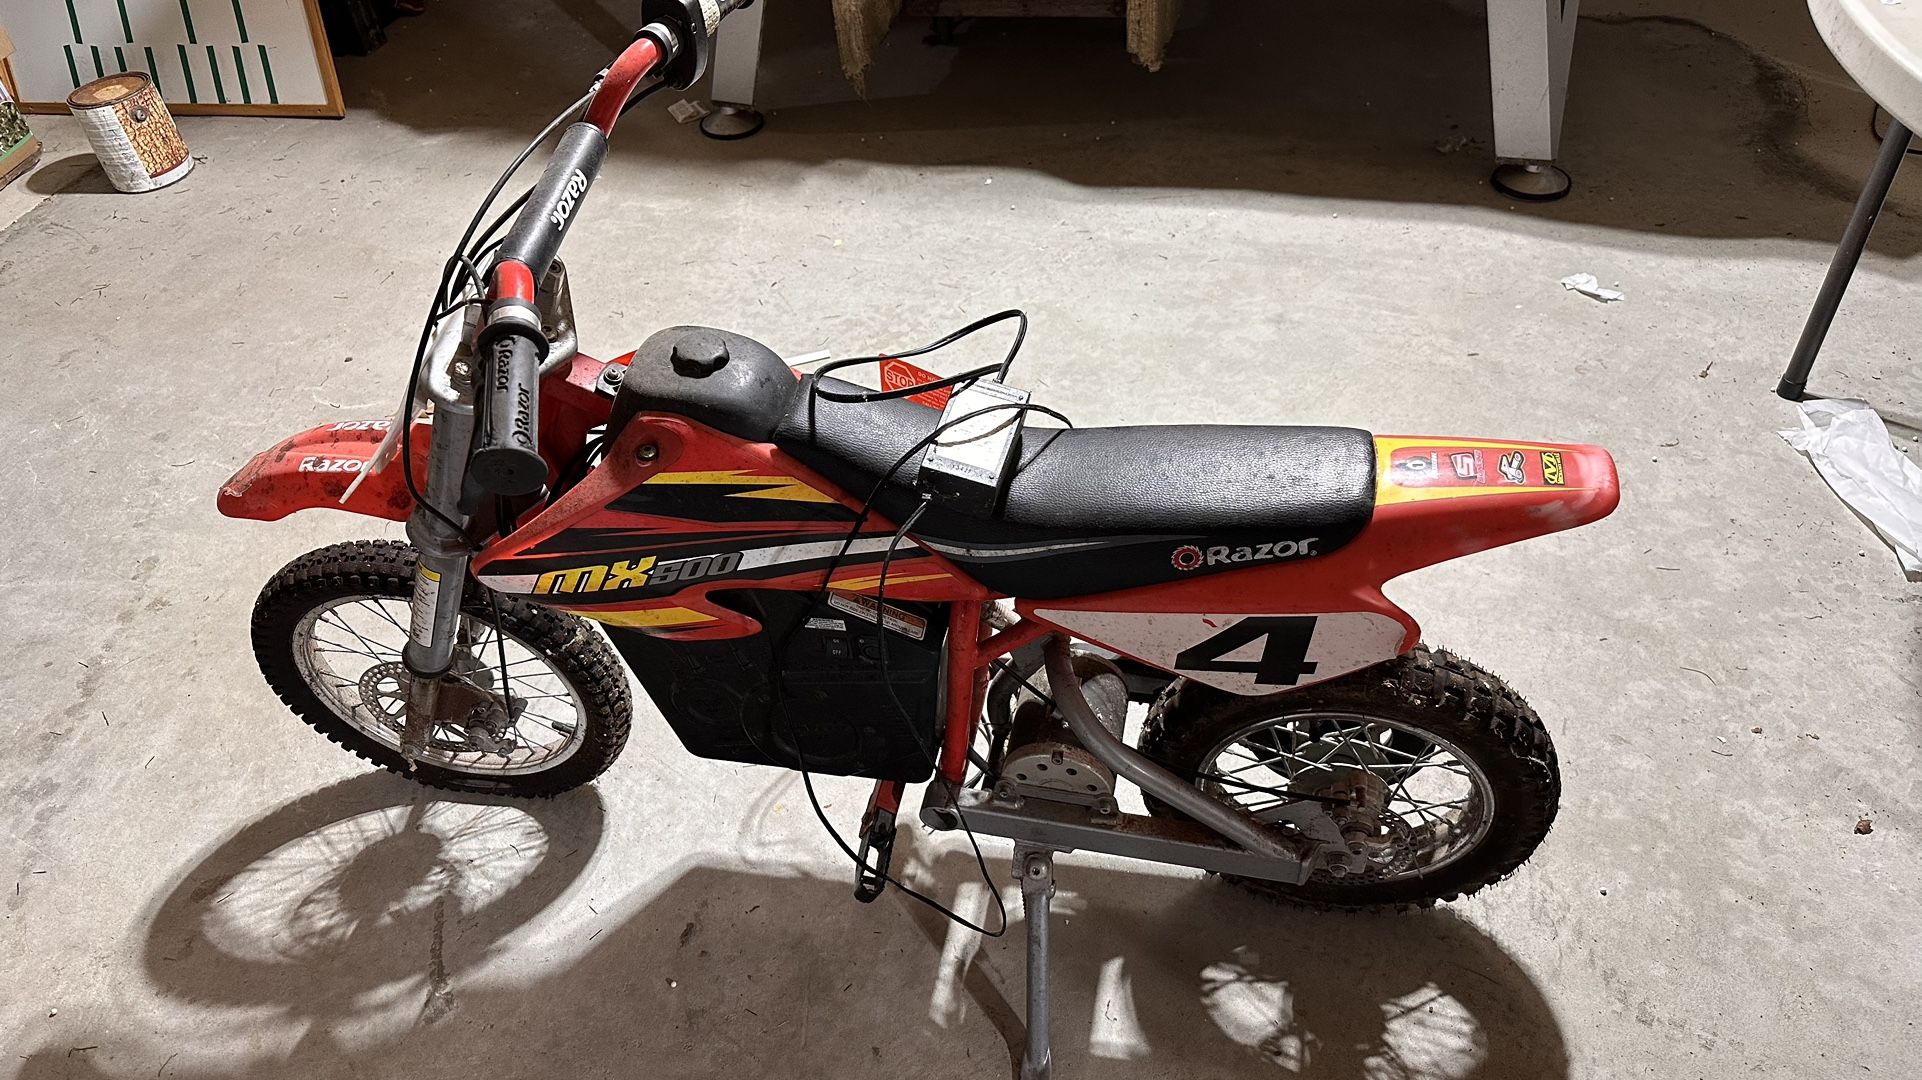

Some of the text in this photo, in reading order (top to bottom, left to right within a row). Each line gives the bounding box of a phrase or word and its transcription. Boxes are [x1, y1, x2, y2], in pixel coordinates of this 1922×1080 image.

[886, 370, 914, 388] STOP
[326, 420, 392, 432] azor
[861, 597, 905, 621] WANING
[1174, 616, 1319, 685] 4
